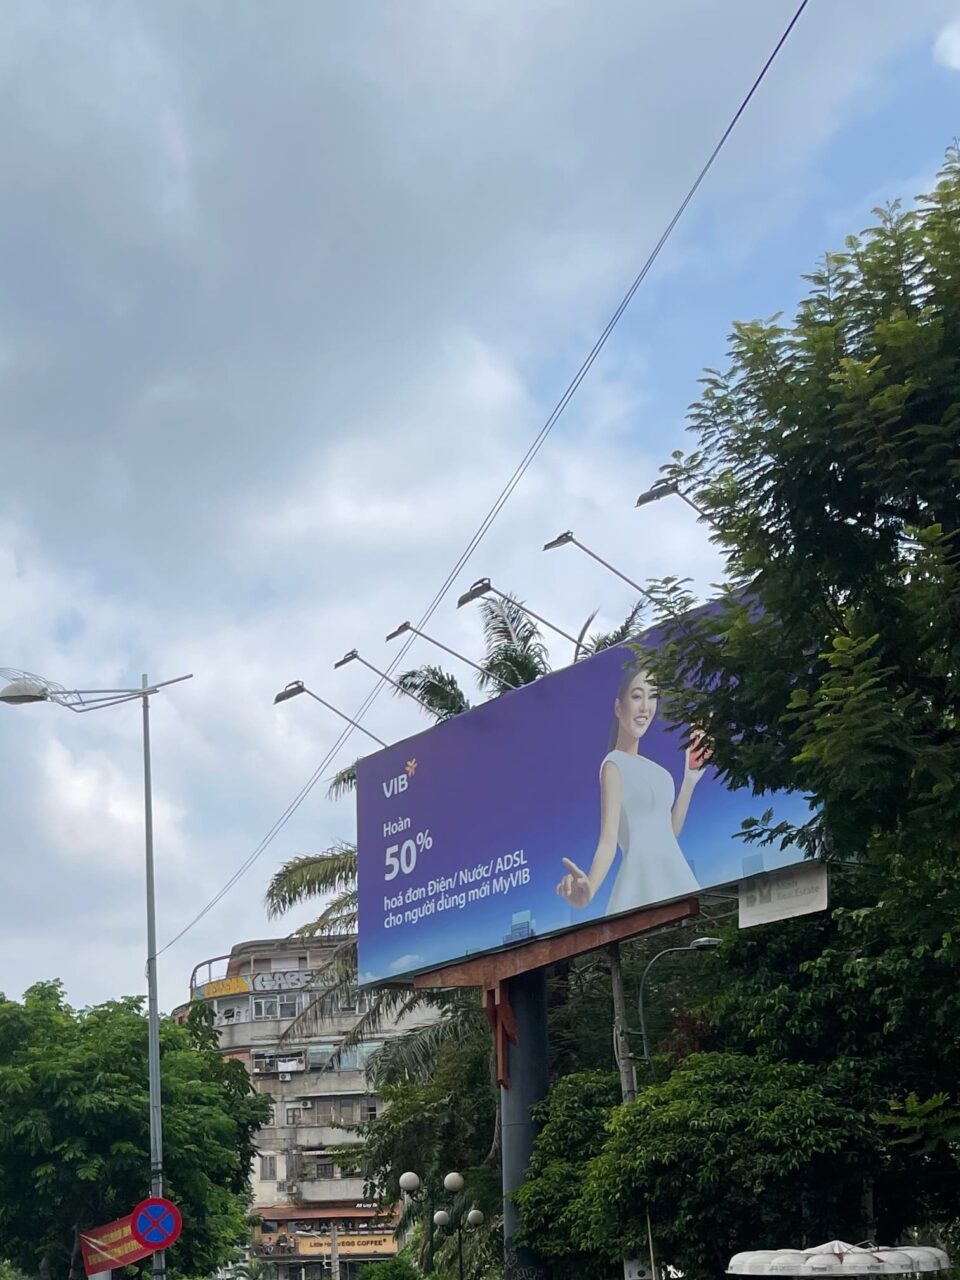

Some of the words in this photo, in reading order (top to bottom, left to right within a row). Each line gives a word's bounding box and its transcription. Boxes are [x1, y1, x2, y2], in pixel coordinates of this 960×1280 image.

[382, 774, 409, 798] VIB
[383, 816, 411, 837] Hoàn
[384, 829, 433, 881] 50%
[384, 892, 403, 911] hoá
[404, 887, 426, 903] đơn
[428, 872, 457, 895] Điện/
[459, 860, 493, 885] Nước/
[495, 849, 528, 873] ADSL
[384, 912, 403, 929] cho
[404, 900, 435, 924] người
[437, 891, 466, 912] dùng
[468, 881, 491, 902] mới
[492, 867, 531, 894] MyVIB
[341, 1239, 356, 1247] EGG
[356, 1239, 383, 1247] COFFEE
